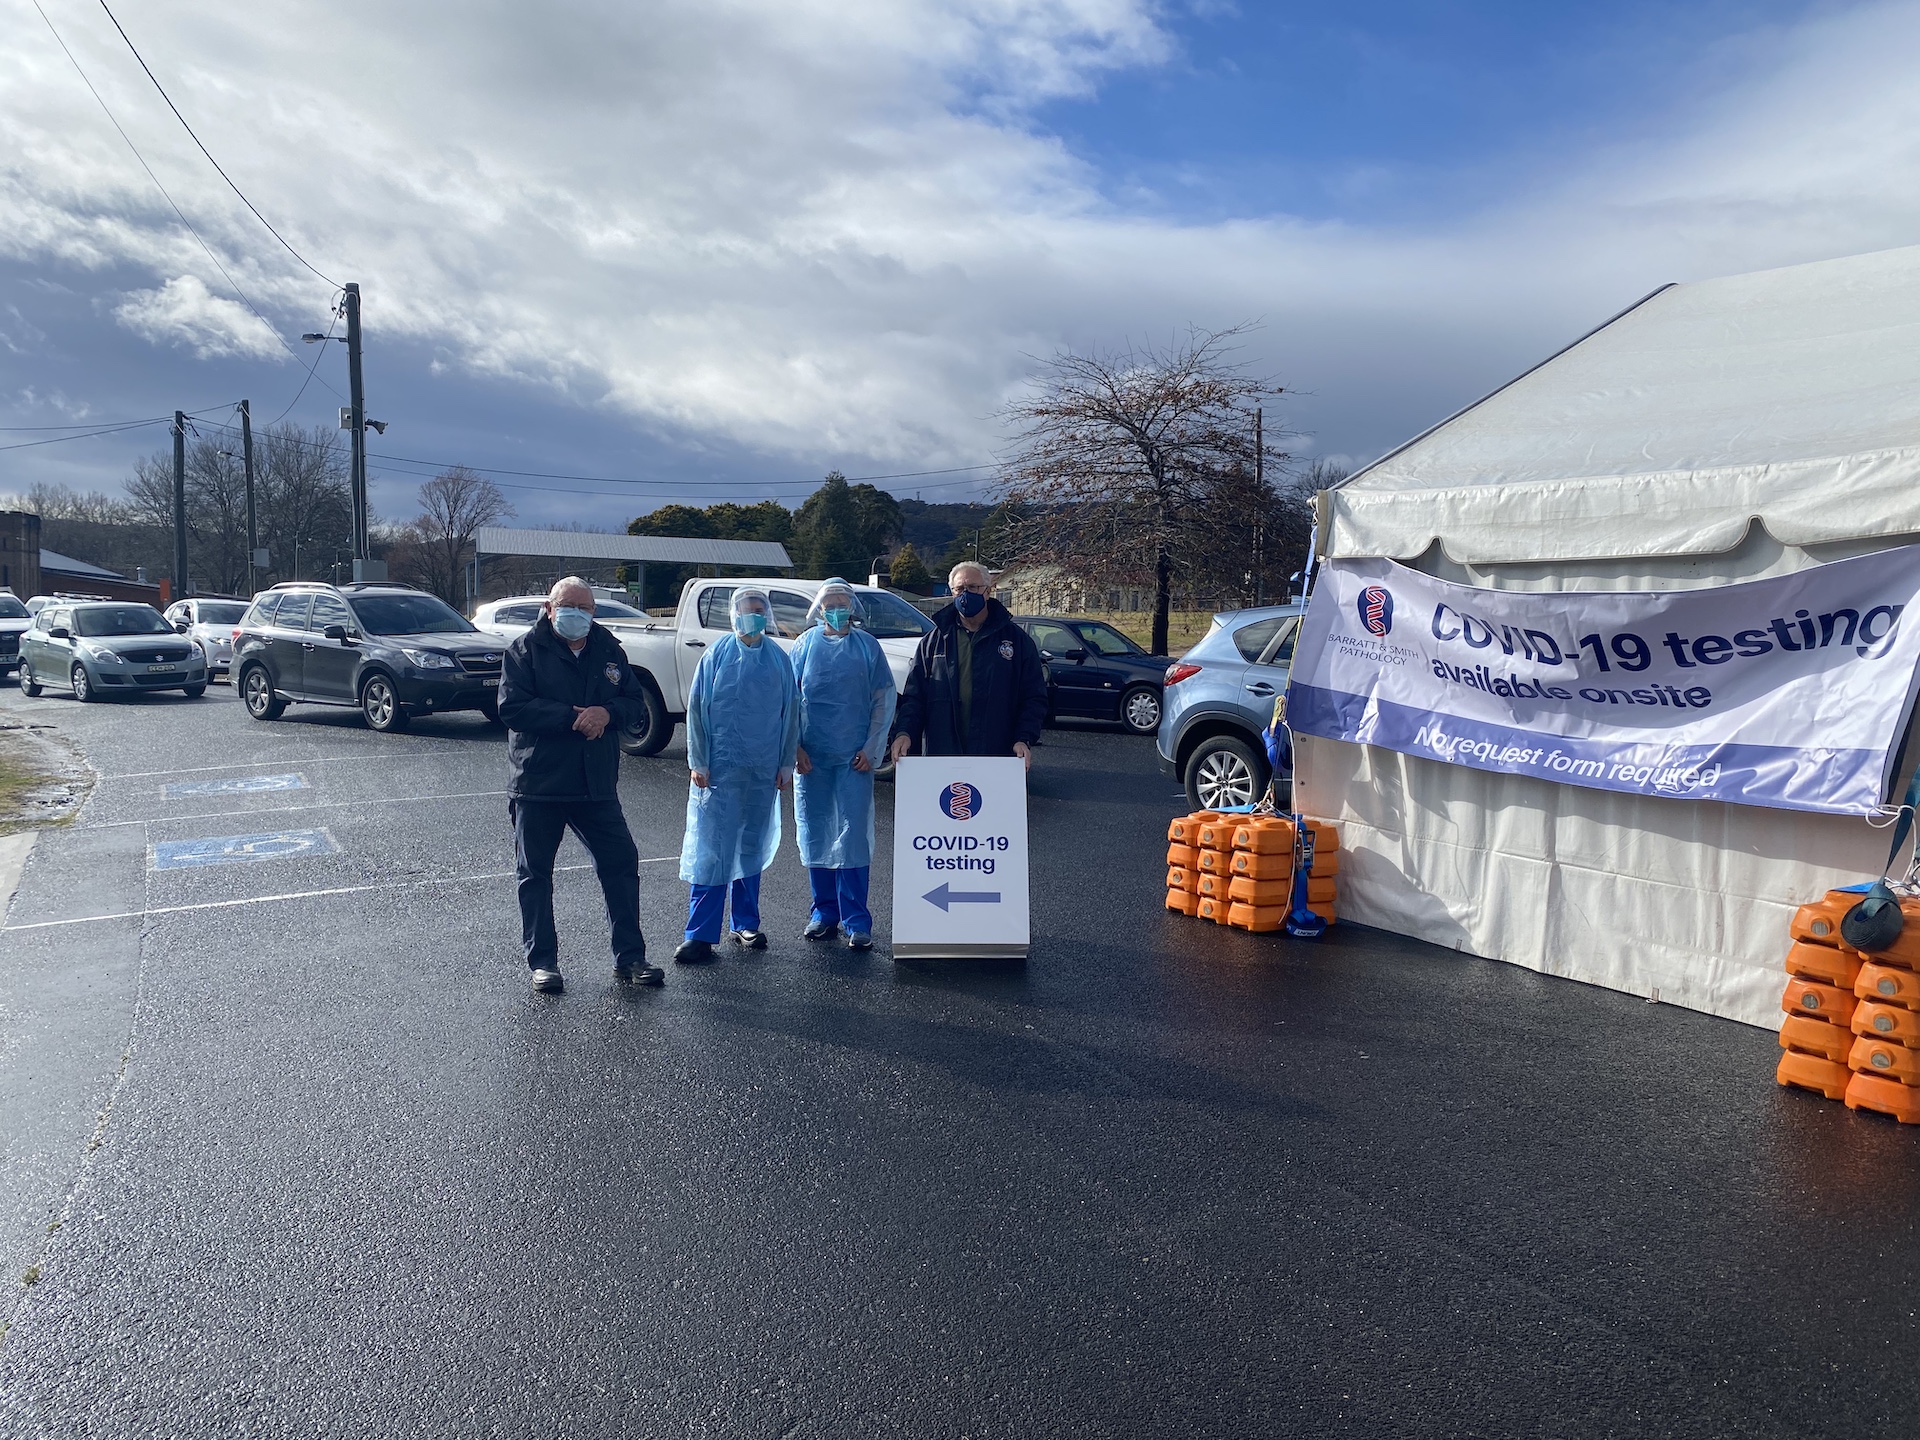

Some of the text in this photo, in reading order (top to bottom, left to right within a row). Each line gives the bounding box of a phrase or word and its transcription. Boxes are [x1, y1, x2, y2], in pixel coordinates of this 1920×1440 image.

[1328, 633, 1419, 659] BARRATT & SMITH
[1431, 602, 1905, 672] COVID-19 testing
[1339, 646, 1407, 666] PATHOLOGY
[1431, 658, 1712, 708] available onsite
[1413, 726, 1722, 789] No request form required
[912, 836, 1009, 851] COVID-19
[926, 854, 995, 875] testing
